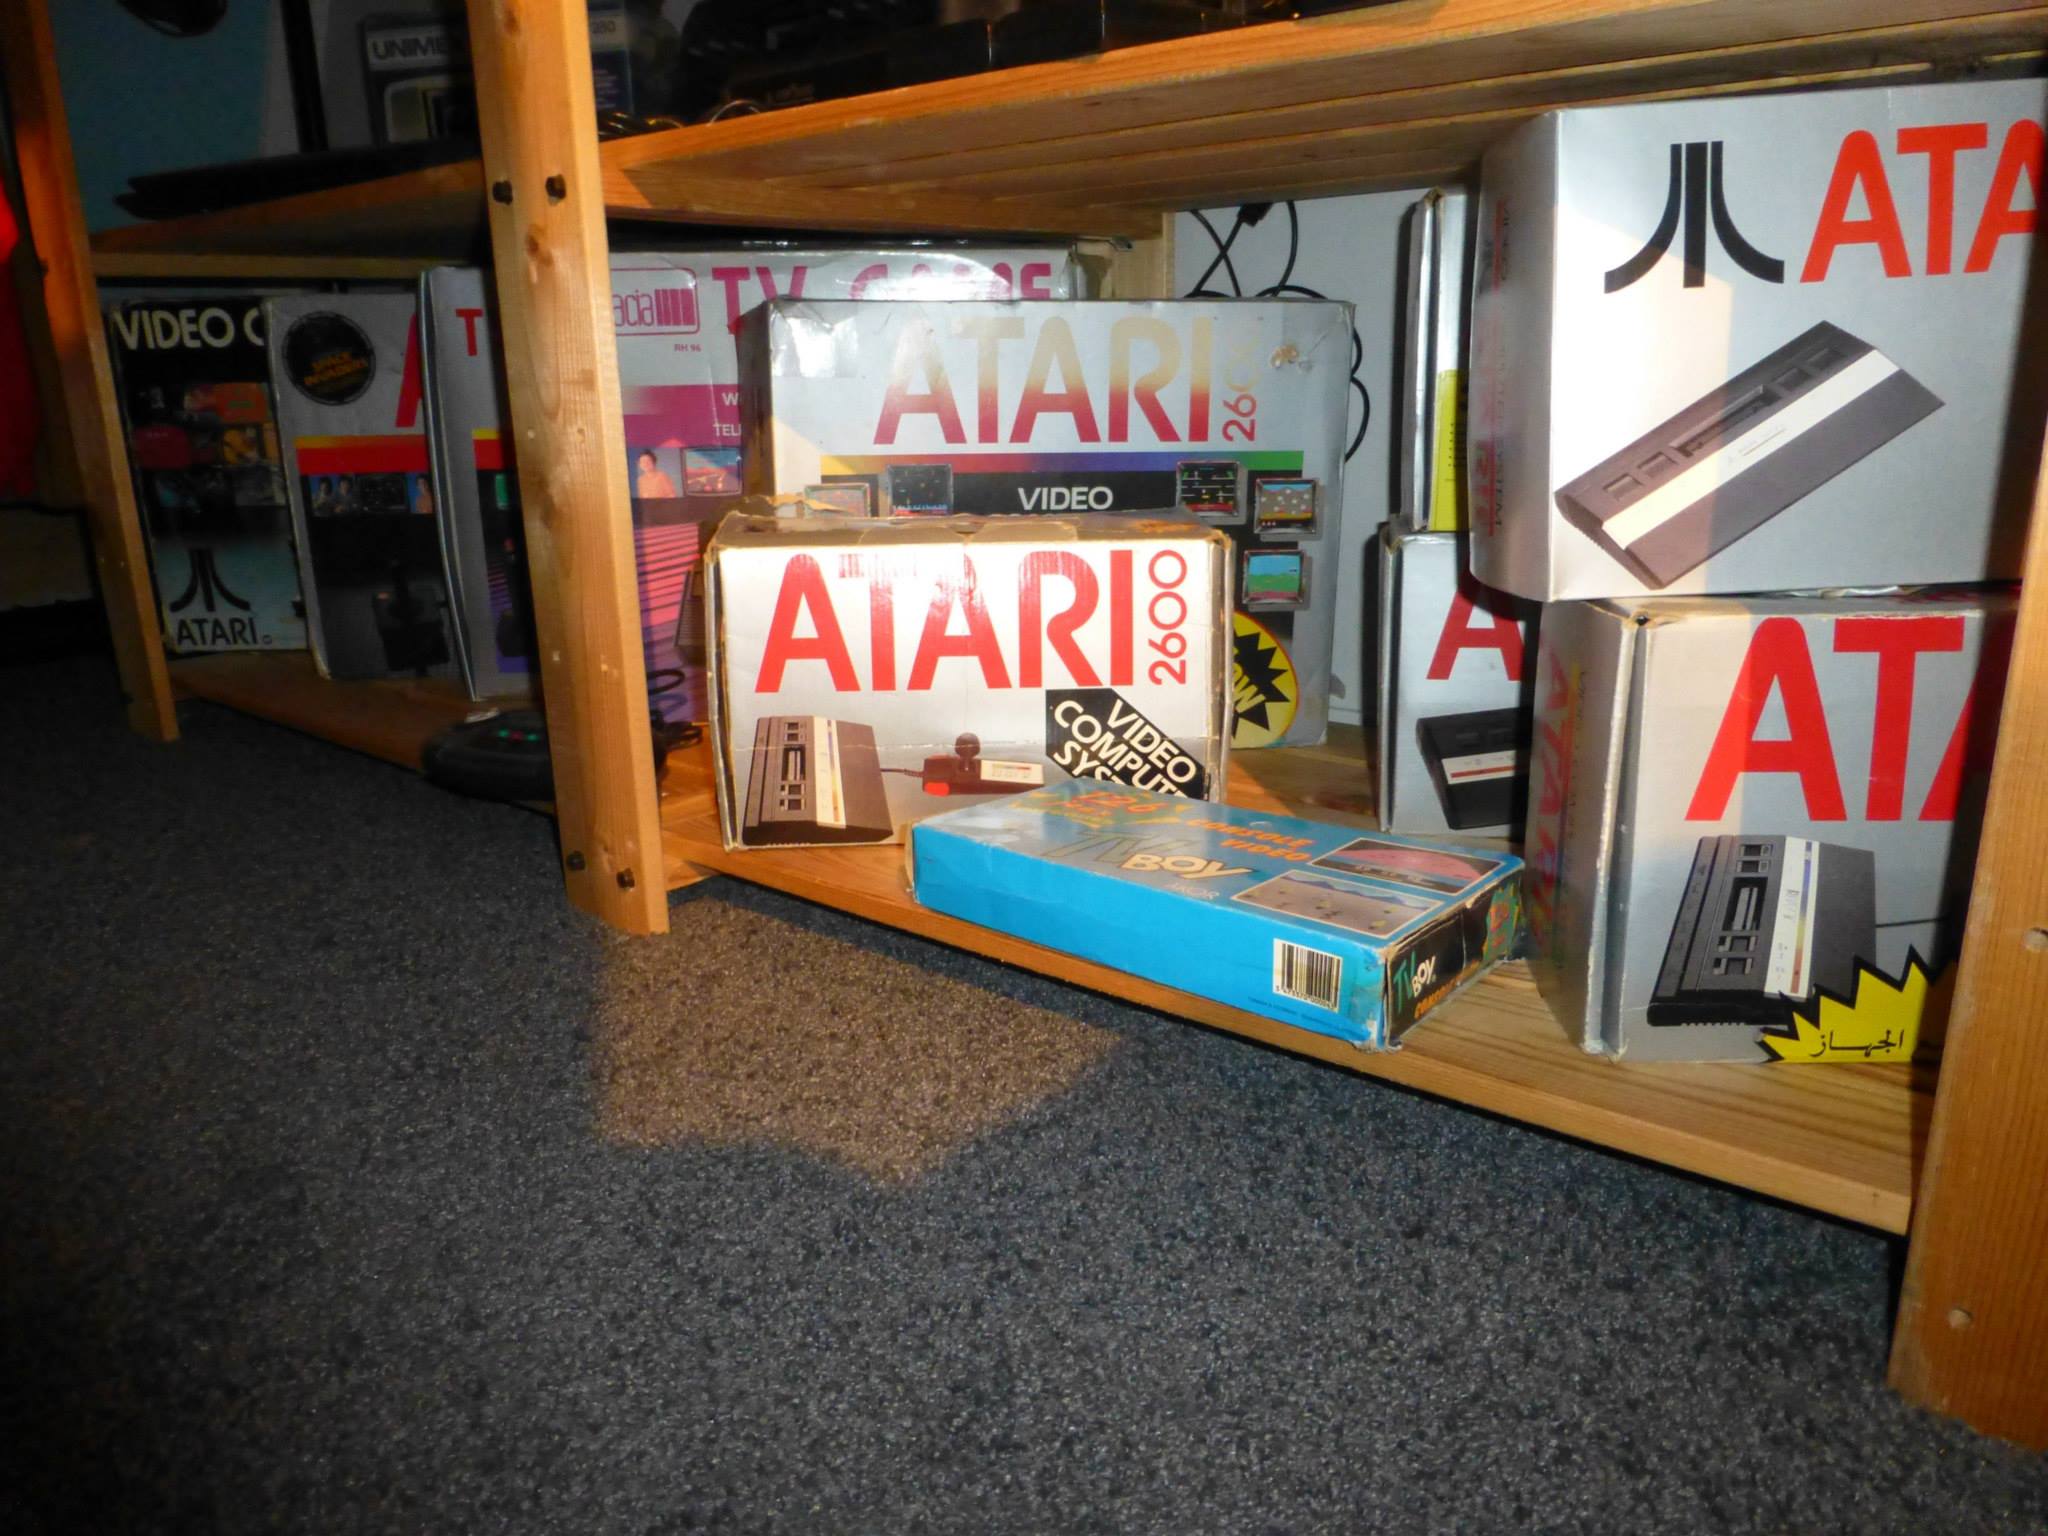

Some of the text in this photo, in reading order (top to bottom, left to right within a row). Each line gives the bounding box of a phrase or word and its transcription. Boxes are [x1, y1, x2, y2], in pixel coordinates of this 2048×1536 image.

[1800, 119, 2045, 283] ATA
[113, 308, 235, 349] VIDEO
[712, 264, 807, 336] TV
[873, 316, 1213, 445] ATARI
[1018, 486, 1114, 511] VIDEO
[177, 617, 257, 646] ATARI
[755, 550, 1188, 693] ATARI 2600
[1054, 700, 1188, 798] COMPUT
[1107, 699, 1196, 783] VIDEO
[1685, 616, 1970, 821] AT
[1053, 740, 1126, 786] SYS
[1120, 853, 1254, 880] BOY
[1220, 839, 1312, 861] VIDEO
[1393, 951, 1416, 1013] TV
[1412, 956, 1436, 998] BOY
[1809, 1029, 1905, 1058] الجهاز
